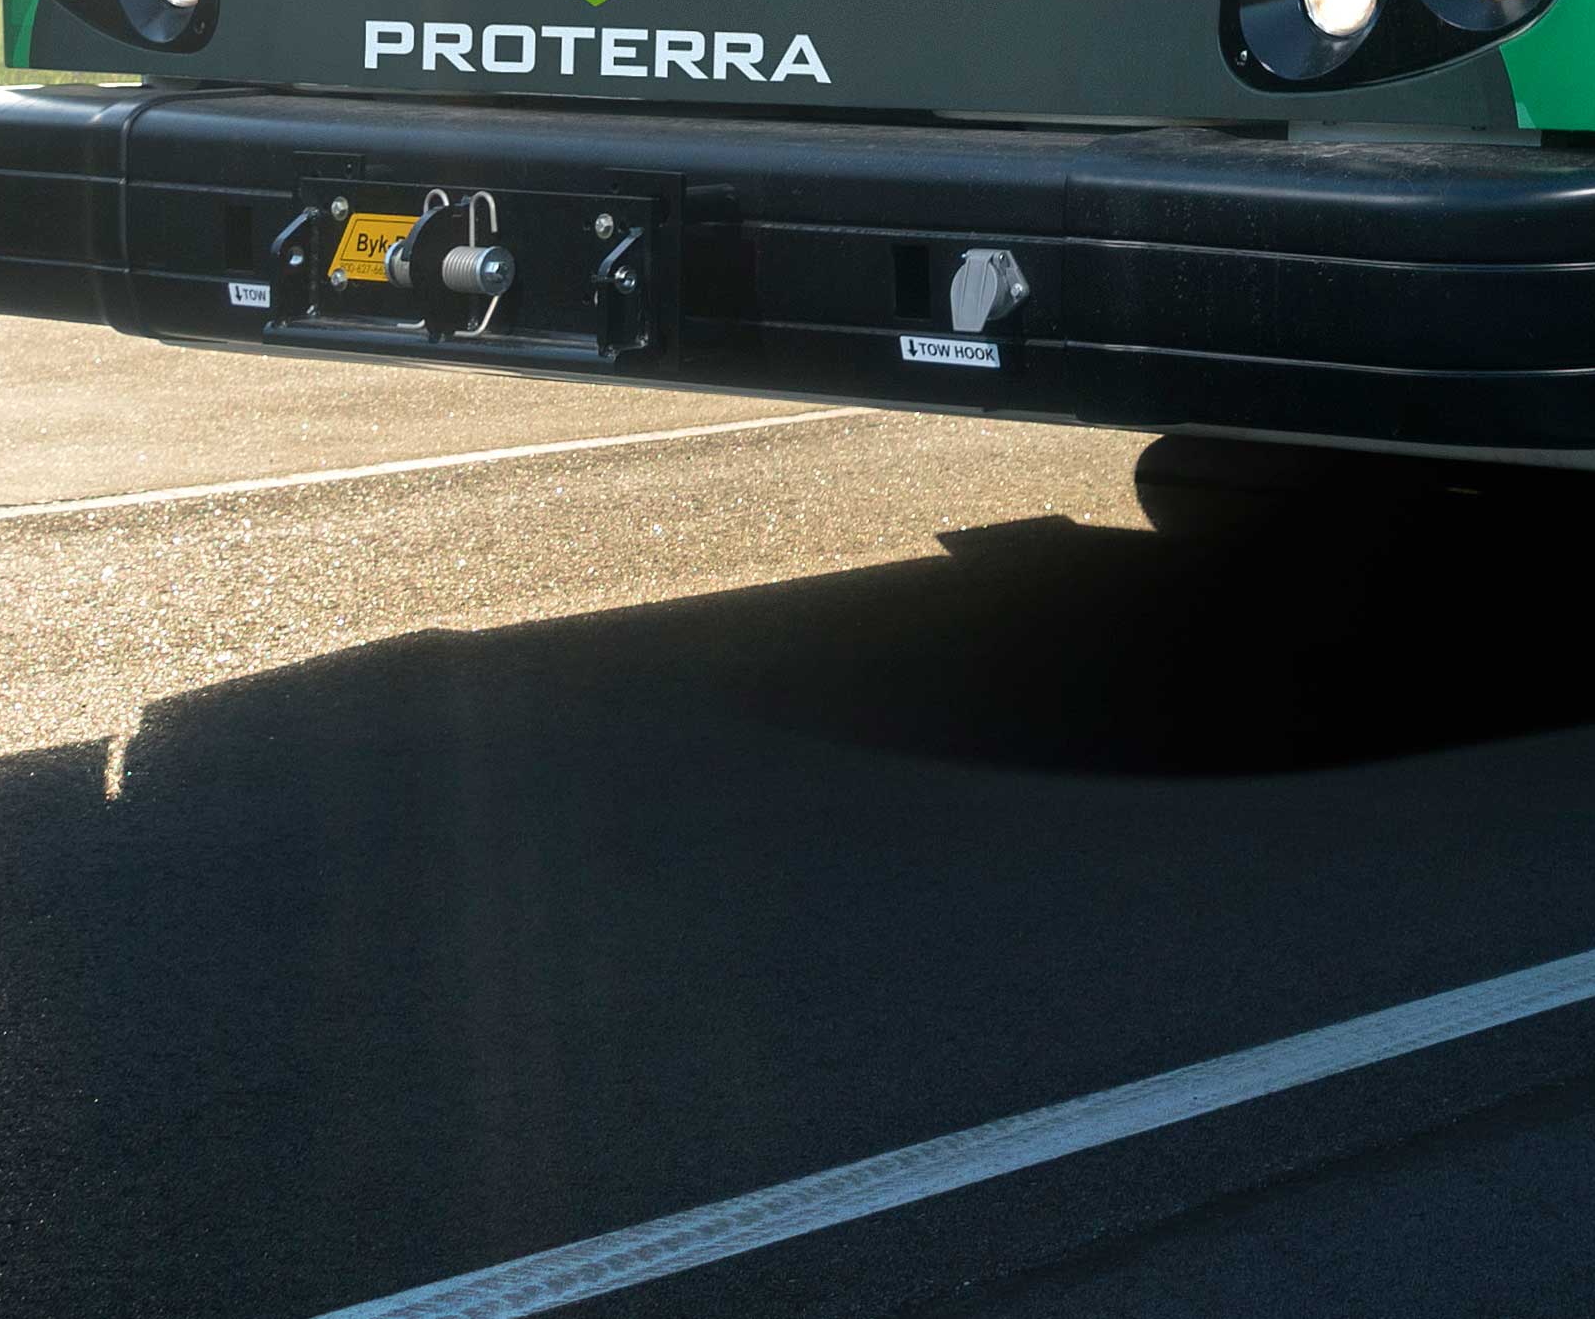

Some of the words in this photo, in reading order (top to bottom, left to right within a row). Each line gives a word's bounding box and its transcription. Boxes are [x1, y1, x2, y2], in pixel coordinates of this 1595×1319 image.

[364, 20, 832, 84] PROTERRA
[242, 288, 267, 302] TOW
[917, 342, 951, 358] TOW
[954, 346, 996, 362] HOOK
